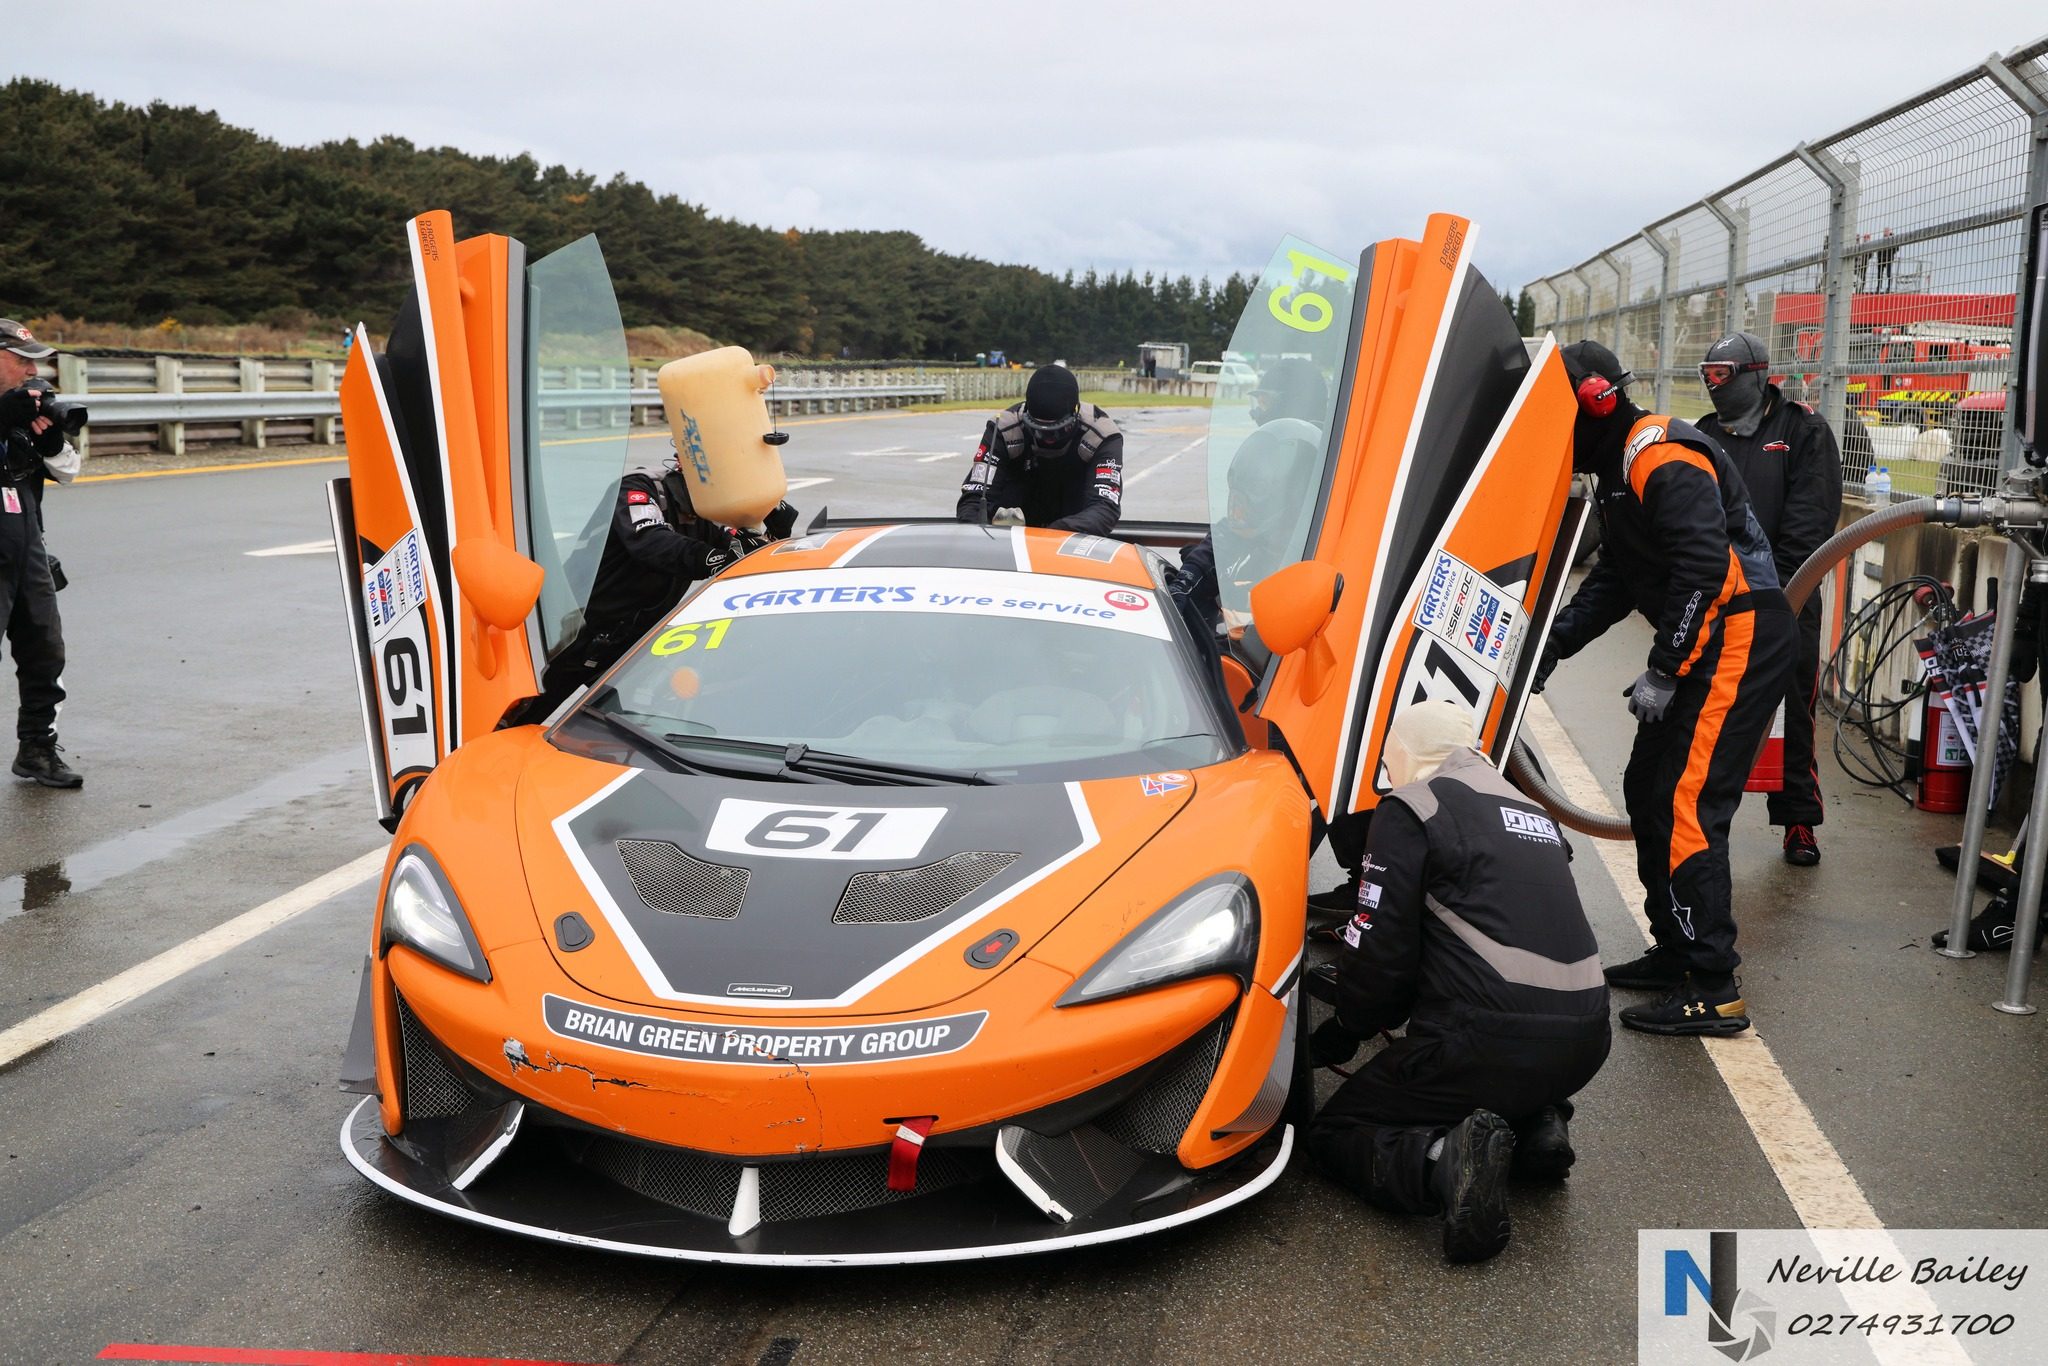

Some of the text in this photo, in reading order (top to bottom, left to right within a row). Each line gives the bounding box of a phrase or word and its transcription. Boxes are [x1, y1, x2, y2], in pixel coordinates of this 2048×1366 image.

[1440, 219, 1458, 266] D.ROGERS
[1446, 231, 1463, 271] B.GREEN
[1268, 249, 1348, 332] 61
[407, 533, 423, 601] CARTER'S
[1420, 556, 1452, 625] CARTER'S
[368, 581, 379, 614] Mobil
[383, 568, 396, 618] Allied
[723, 586, 1116, 619] CARTER'S tyre service
[1436, 571, 1457, 620] tyre service
[650, 618, 734, 656] 61
[1465, 589, 1490, 648] Allied
[1488, 624, 1508, 660] Mobil
[384, 637, 427, 735] 61
[745, 810, 887, 852] 61
[564, 1008, 951, 1057] BRIAN GREEN PROPERTY GROUP
